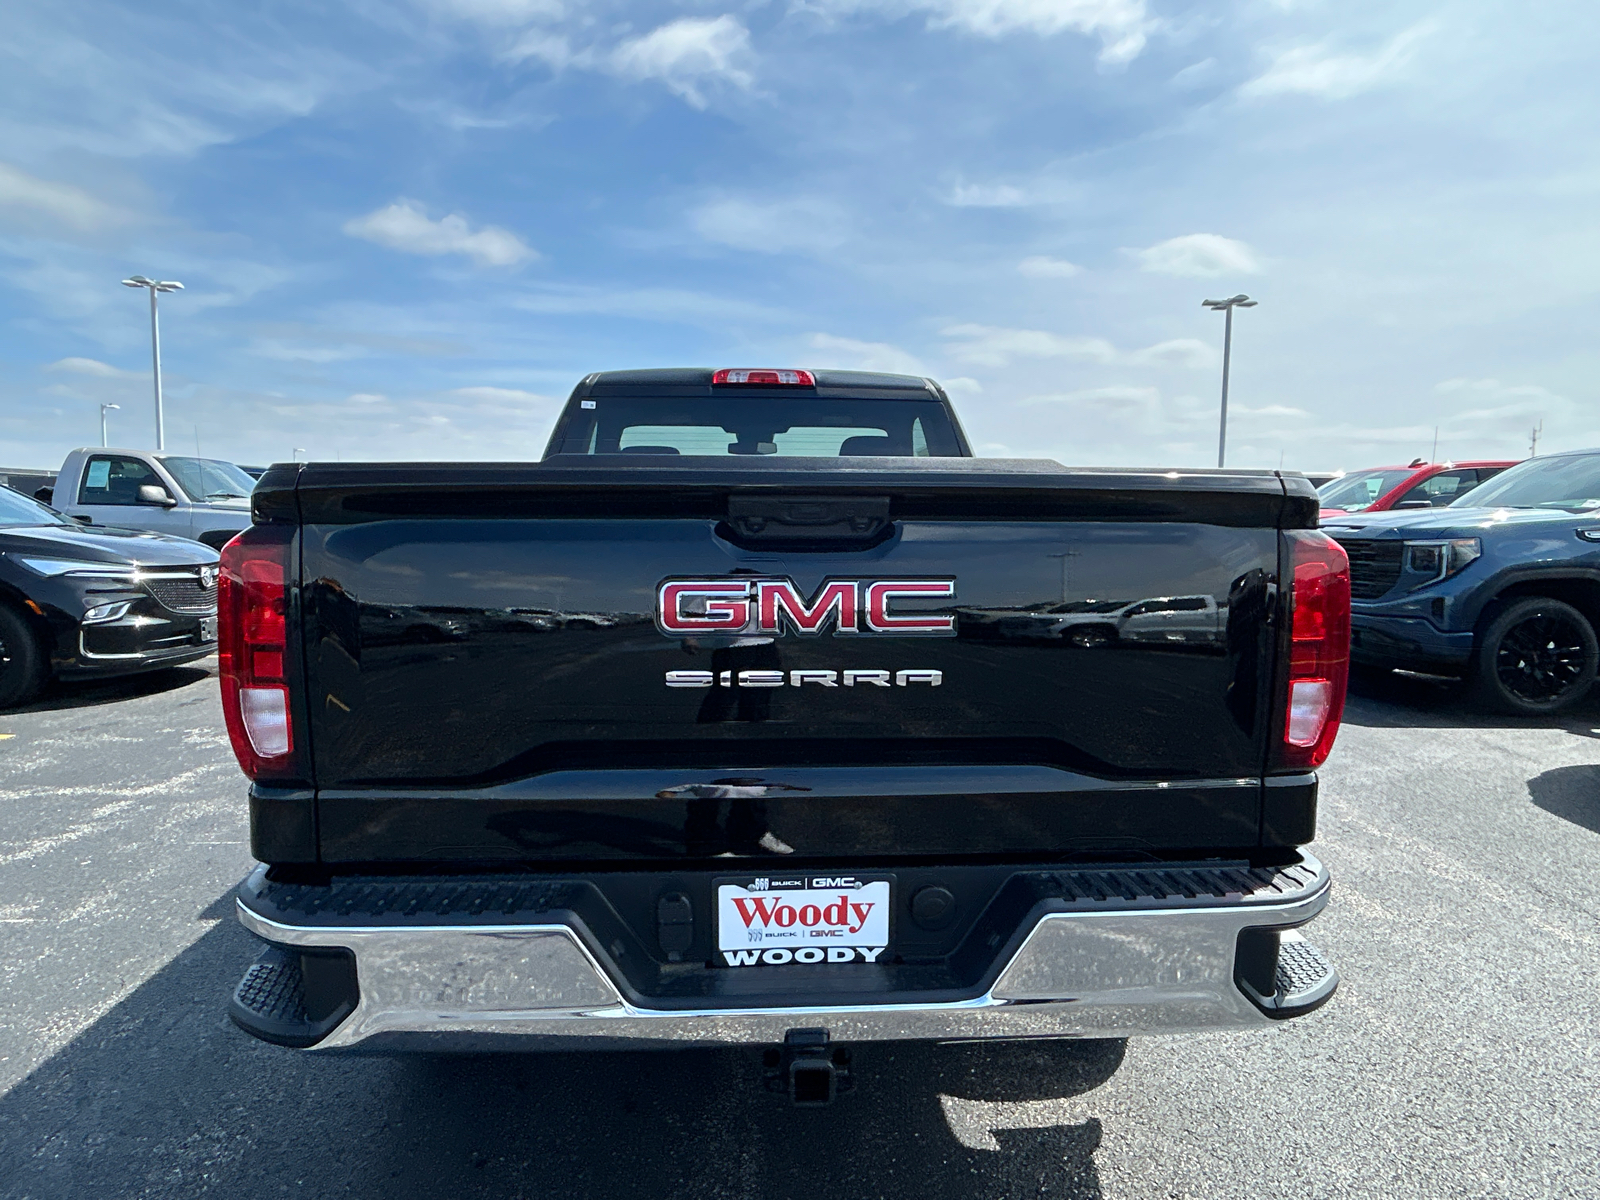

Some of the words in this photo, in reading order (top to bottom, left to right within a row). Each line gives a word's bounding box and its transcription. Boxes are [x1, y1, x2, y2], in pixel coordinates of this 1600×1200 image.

[659, 580, 955, 633] GMC
[665, 669, 943, 687] SIERRA
[812, 877, 855, 888] GMC
[731, 895, 875, 933] Woody
[809, 929, 844, 937] GMC
[722, 947, 886, 967] WOODY
